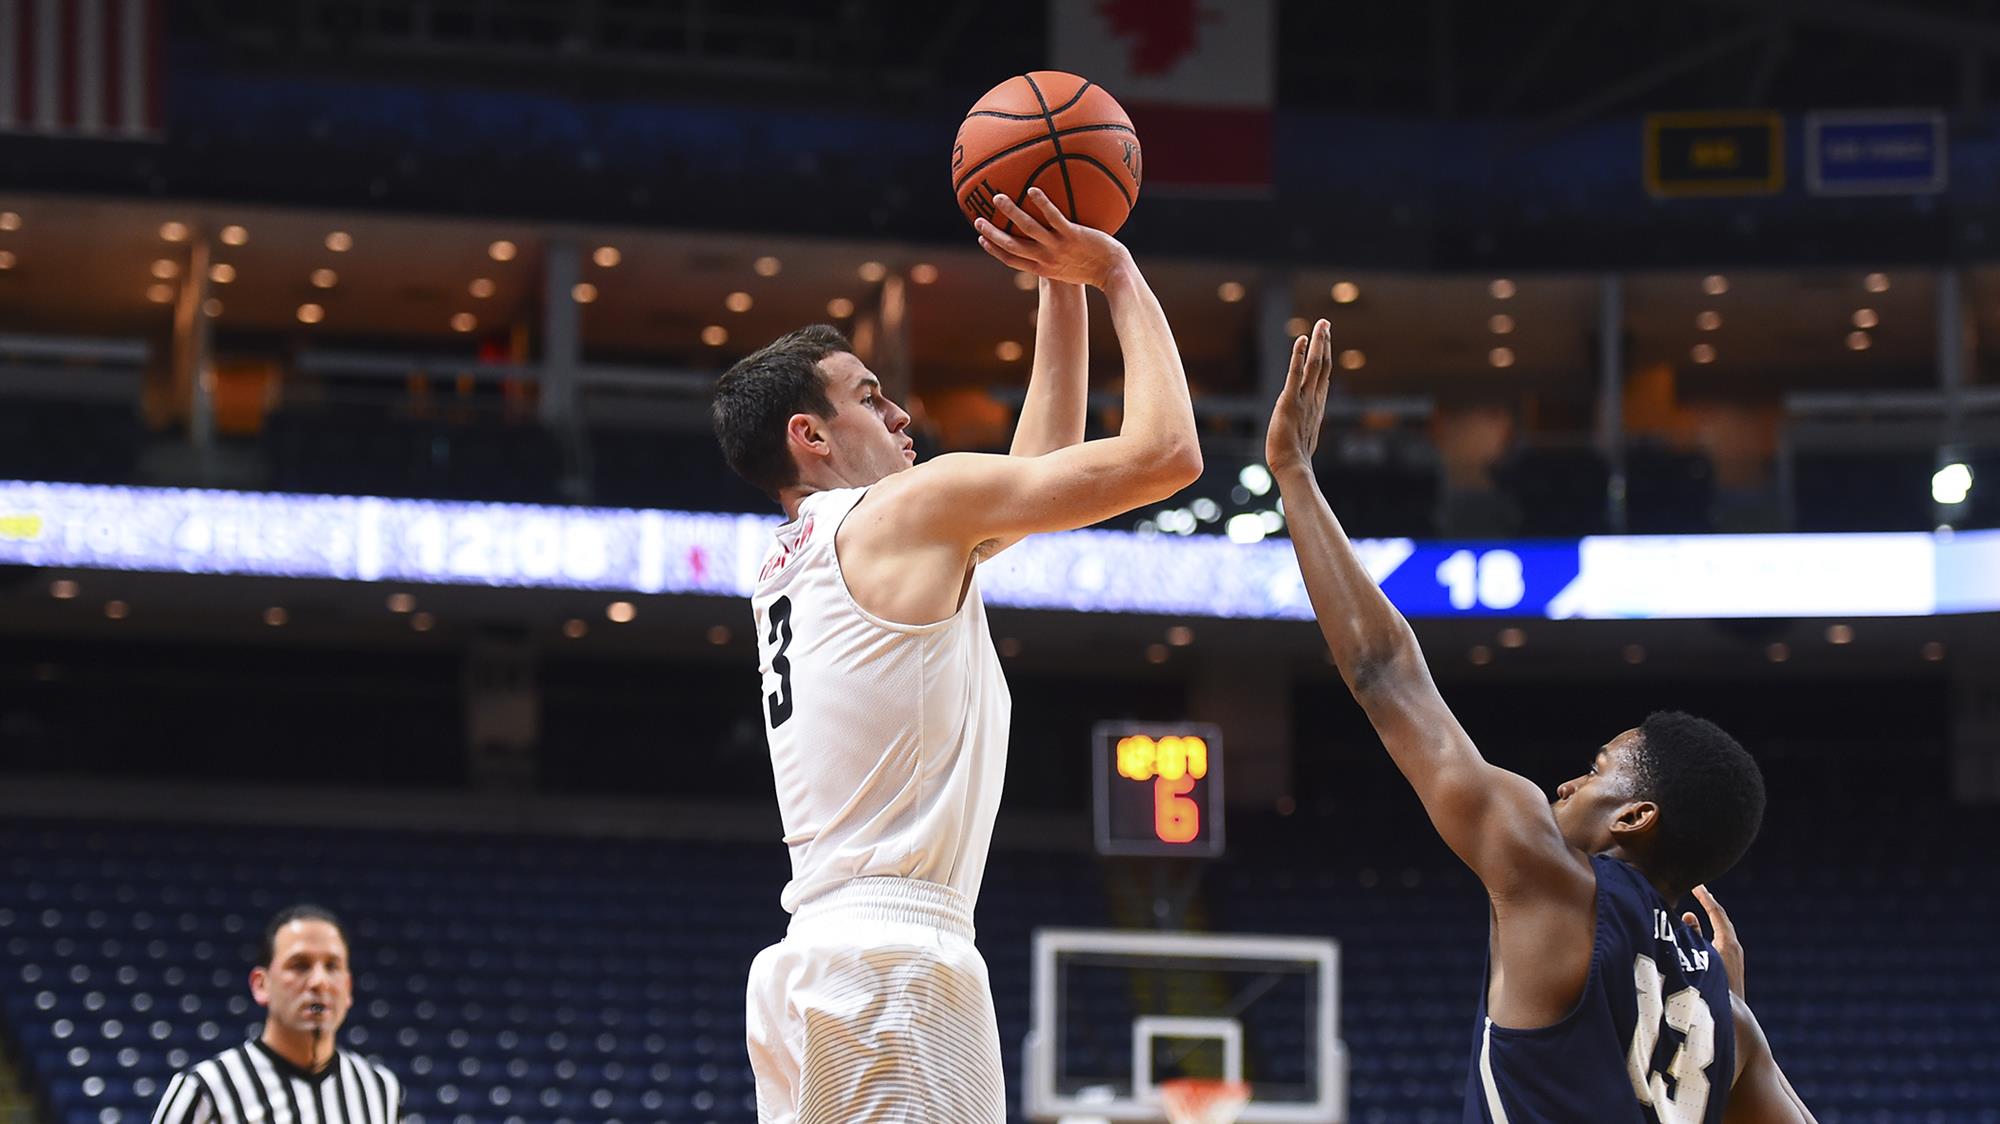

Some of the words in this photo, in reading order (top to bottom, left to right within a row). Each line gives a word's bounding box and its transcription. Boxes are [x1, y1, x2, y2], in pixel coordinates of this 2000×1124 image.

[768, 595, 793, 729] 3
[1154, 772, 1199, 843] 6
[1653, 908, 1709, 972] JOAN
[1627, 953, 1715, 1124] 13
